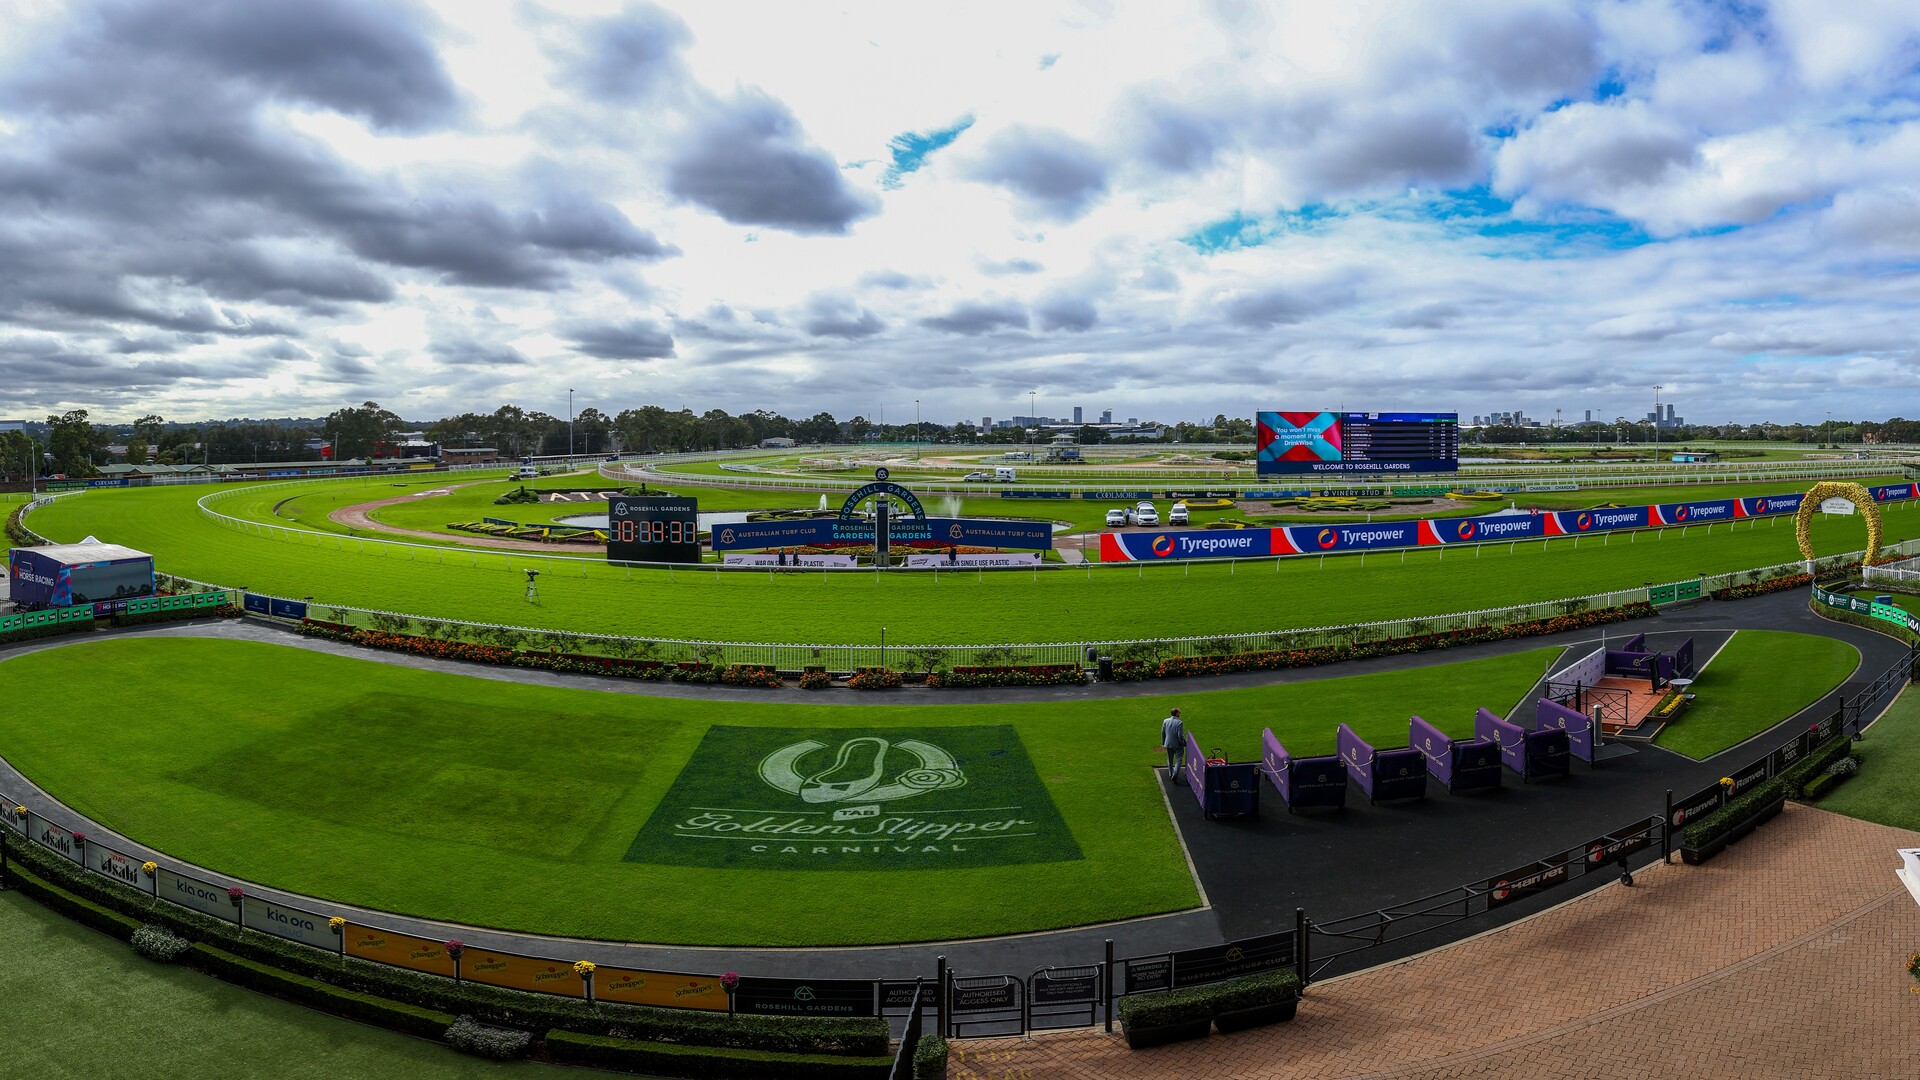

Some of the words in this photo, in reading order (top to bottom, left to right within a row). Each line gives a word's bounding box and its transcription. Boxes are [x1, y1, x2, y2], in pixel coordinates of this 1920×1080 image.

[1886, 488, 1907, 497] Tyrepower
[841, 485, 879, 520] ROSEHILL
[887, 485, 923, 520] GARDENS
[1768, 499, 1797, 509] Tyrepower
[1594, 512, 1638, 525] Tyrepower
[1690, 505, 1725, 517] Tyrepower
[1478, 521, 1531, 535] Tyrepower
[1342, 528, 1404, 544] Tyrepower
[1180, 536, 1252, 552] Tyrepower
[19, 572, 34, 582] HORSE
[35, 575, 54, 587] RACING
[1782, 739, 1799, 754] WORLD
[1737, 768, 1764, 788] Ranvet
[1685, 795, 1718, 818] Ranvet
[675, 813, 848, 834] Golden
[850, 818, 1033, 840] Slipper
[42, 830, 70, 854] Asahi
[751, 845, 966, 853] CARNIVAL
[102, 858, 138, 884] Asahi
[177, 879, 195, 895] kia
[197, 889, 217, 902] ora
[267, 907, 288, 924] kia
[290, 917, 314, 930] ora
[410, 949, 441, 960] Schweppes
[474, 960, 507, 971] Schweppes
[1181, 967, 1237, 982] AUSTRALIAN
[1265, 956, 1286, 965] CLUB
[535, 970, 570, 981] Schweppes
[609, 978, 645, 991] Schweppes
[675, 984, 712, 998] Schweppes
